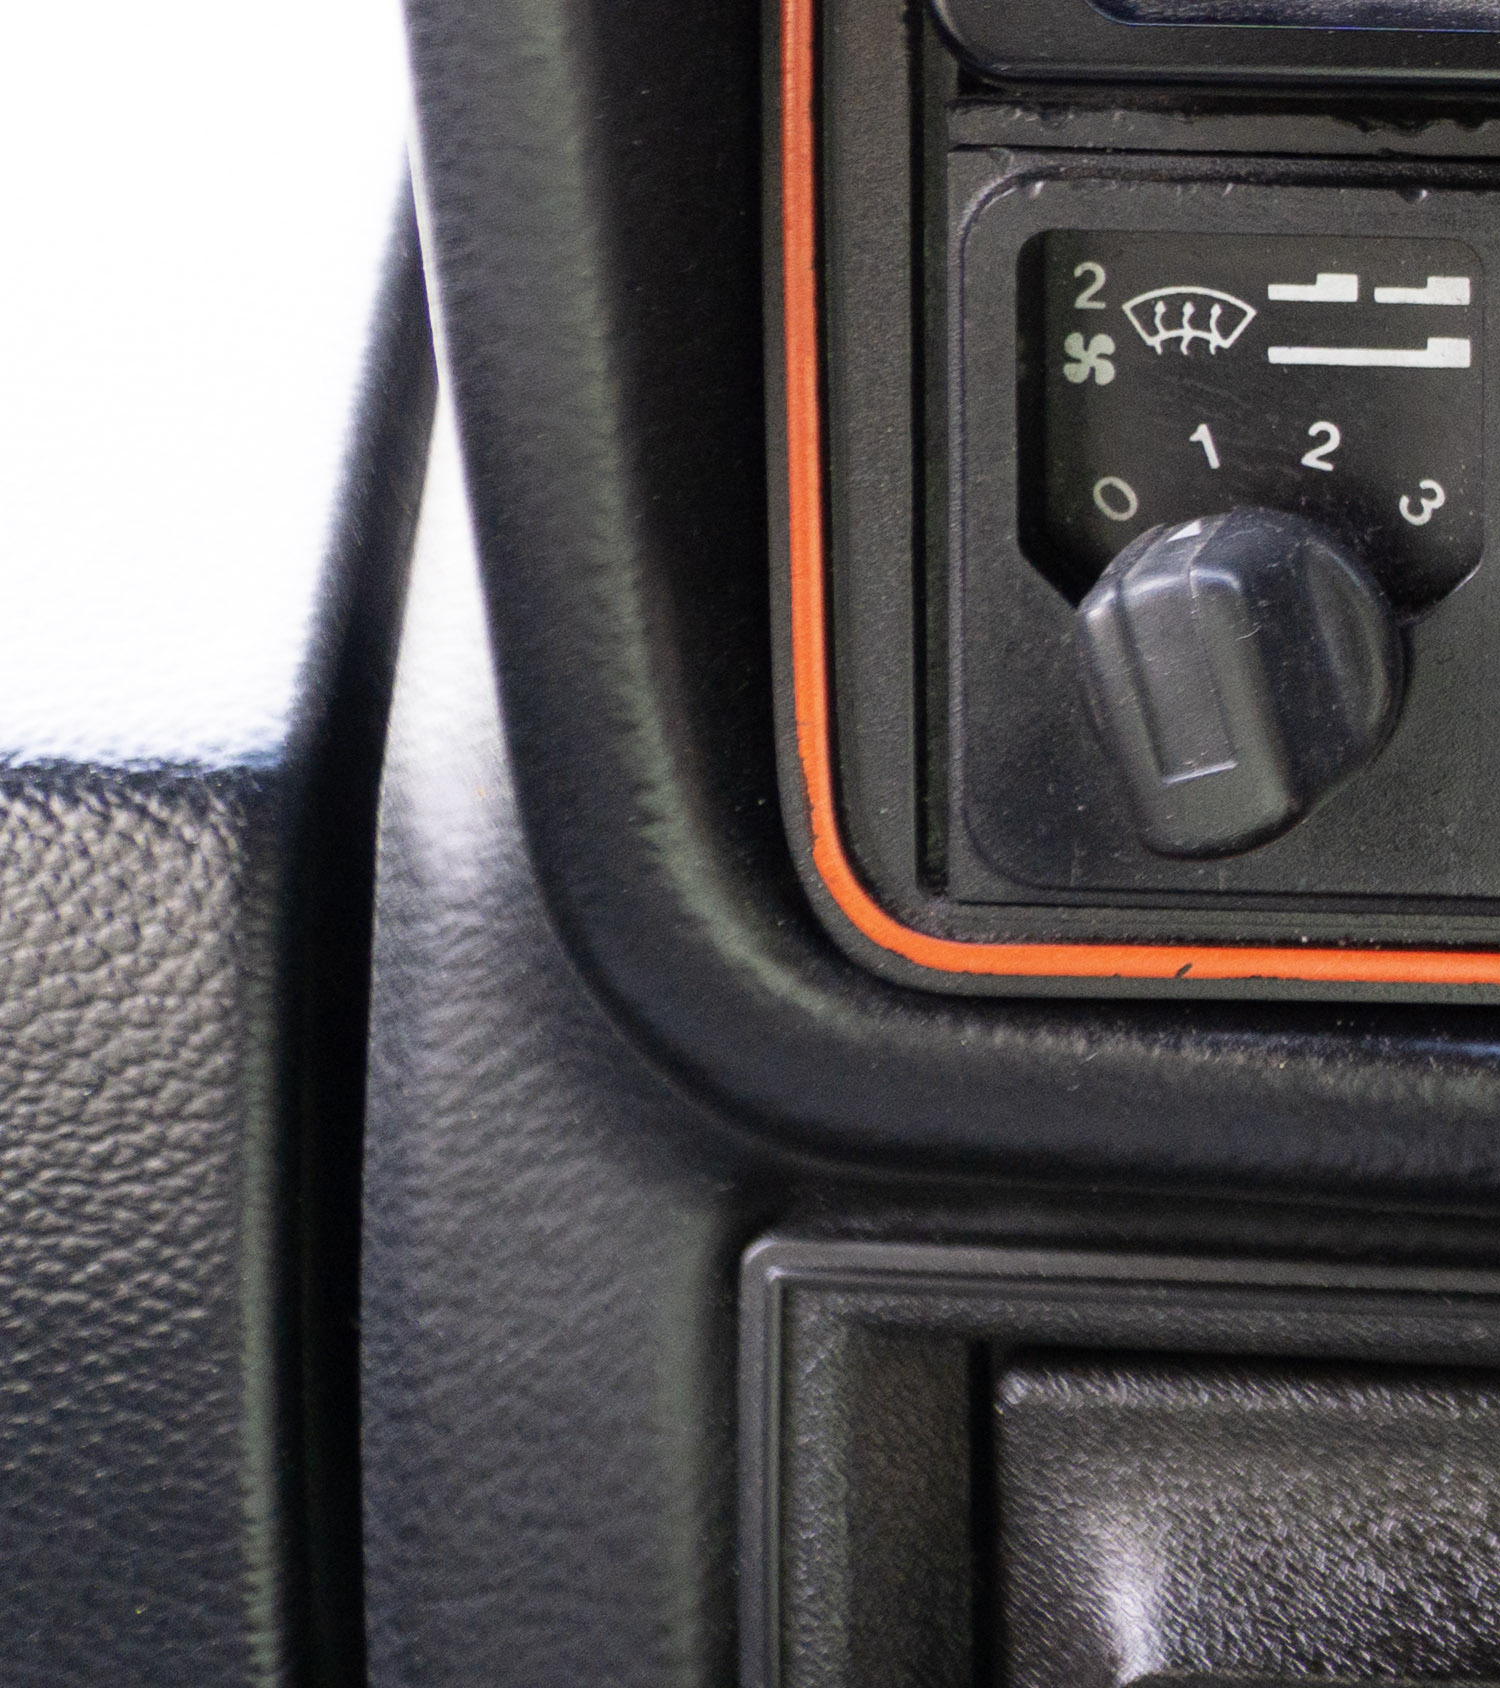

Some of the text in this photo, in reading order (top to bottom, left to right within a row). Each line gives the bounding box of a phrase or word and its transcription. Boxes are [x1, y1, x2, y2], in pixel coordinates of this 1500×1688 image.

[1073, 261, 1106, 310] 2
[1189, 423, 1220, 469] 1
[1301, 421, 1341, 472] 2
[1093, 475, 1138, 521] 0
[1399, 479, 1446, 526] 3
